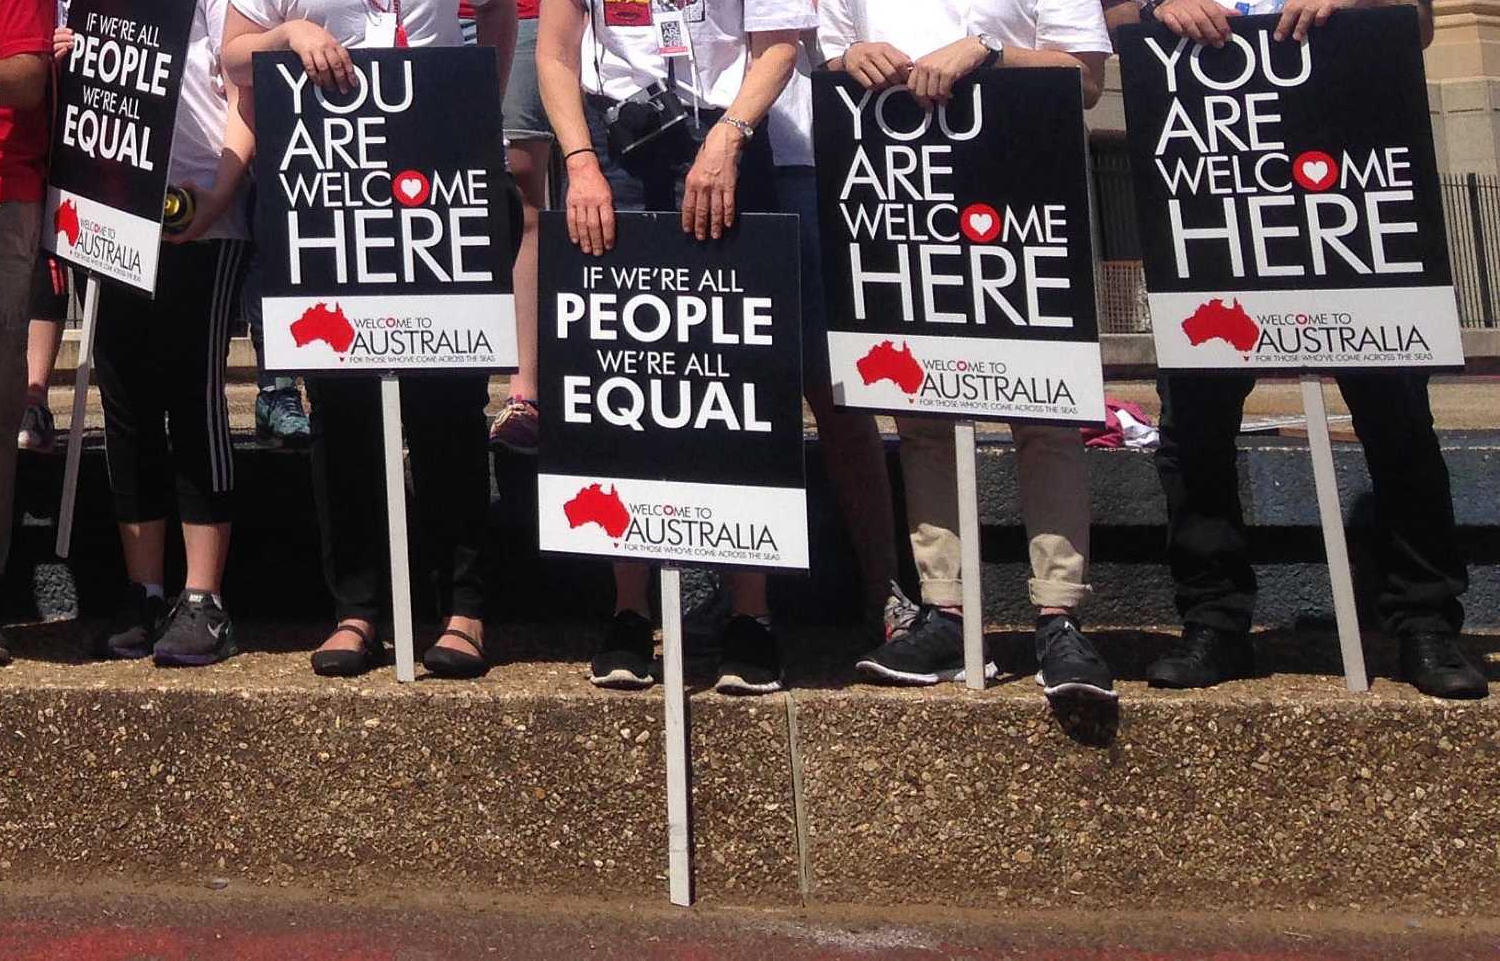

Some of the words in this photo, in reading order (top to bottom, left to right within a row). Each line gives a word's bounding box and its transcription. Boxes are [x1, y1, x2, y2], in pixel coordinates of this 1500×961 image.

[86, 12, 97, 31] IF
[100, 14, 135, 44] WE'RE
[137, 24, 160, 48] ALL
[69, 33, 172, 97] PEOPLE
[1144, 29, 1312, 92] YOU
[83, 85, 117, 112] WE'RE
[119, 96, 140, 121] ALL
[276, 60, 414, 114] YOU
[835, 83, 983, 141] YOU
[1155, 92, 1285, 156] ARE
[63, 104, 153, 172] EQUAL
[280, 117, 388, 171] ARE
[278, 169, 489, 208] WELCOME
[840, 144, 954, 201] ARE
[1155, 146, 1413, 195] WELCOME
[287, 207, 493, 285] HERE
[839, 202, 1068, 244] WELCOME
[1168, 190, 1424, 278] HERE
[75, 229, 142, 275] AUSTRALIA
[583, 267, 603, 288] IF
[610, 267, 690, 291] WE'RE
[699, 269, 744, 292] ALL
[849, 242, 1074, 328] HERE
[353, 317, 412, 329] WELCOME
[416, 317, 432, 329] TO
[556, 292, 773, 346] PEOPLE
[1255, 325, 1430, 354] AUSTRALIA
[1256, 313, 1327, 326] WELCOME
[1331, 312, 1351, 325] TO
[350, 329, 493, 356] AUSTRALIA
[597, 350, 676, 376] WE'RE
[684, 353, 730, 377] ALL
[919, 372, 1076, 406] AUSTRALIA
[922, 358, 985, 373] WELCOME
[989, 361, 1007, 374] TO
[563, 375, 772, 432] EQUAL
[629, 502, 691, 518] WELCOME
[694, 507, 712, 519] TO
[625, 517, 778, 552] AUSTRALIA
